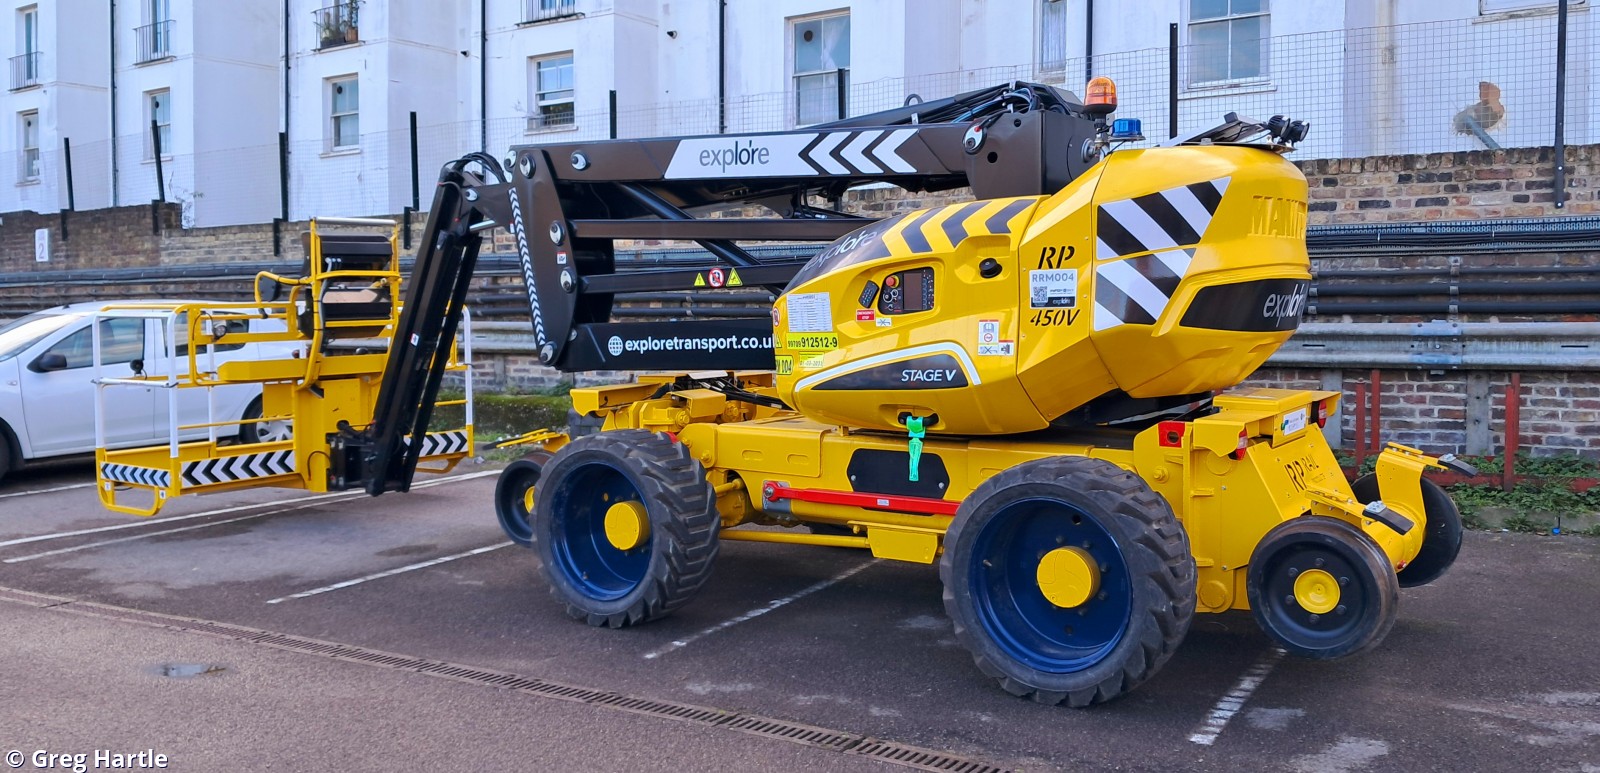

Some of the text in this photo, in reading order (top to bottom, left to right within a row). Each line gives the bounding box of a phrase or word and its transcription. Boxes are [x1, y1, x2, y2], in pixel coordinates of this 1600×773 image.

[698, 139, 770, 173] explore
[38, 243, 45, 259] 2
[803, 230, 878, 272] explore
[1037, 246, 1075, 269] RP
[1032, 272, 1074, 283] RRM004
[1030, 309, 1081, 327] 450V
[901, 369, 957, 381] STAGE V
